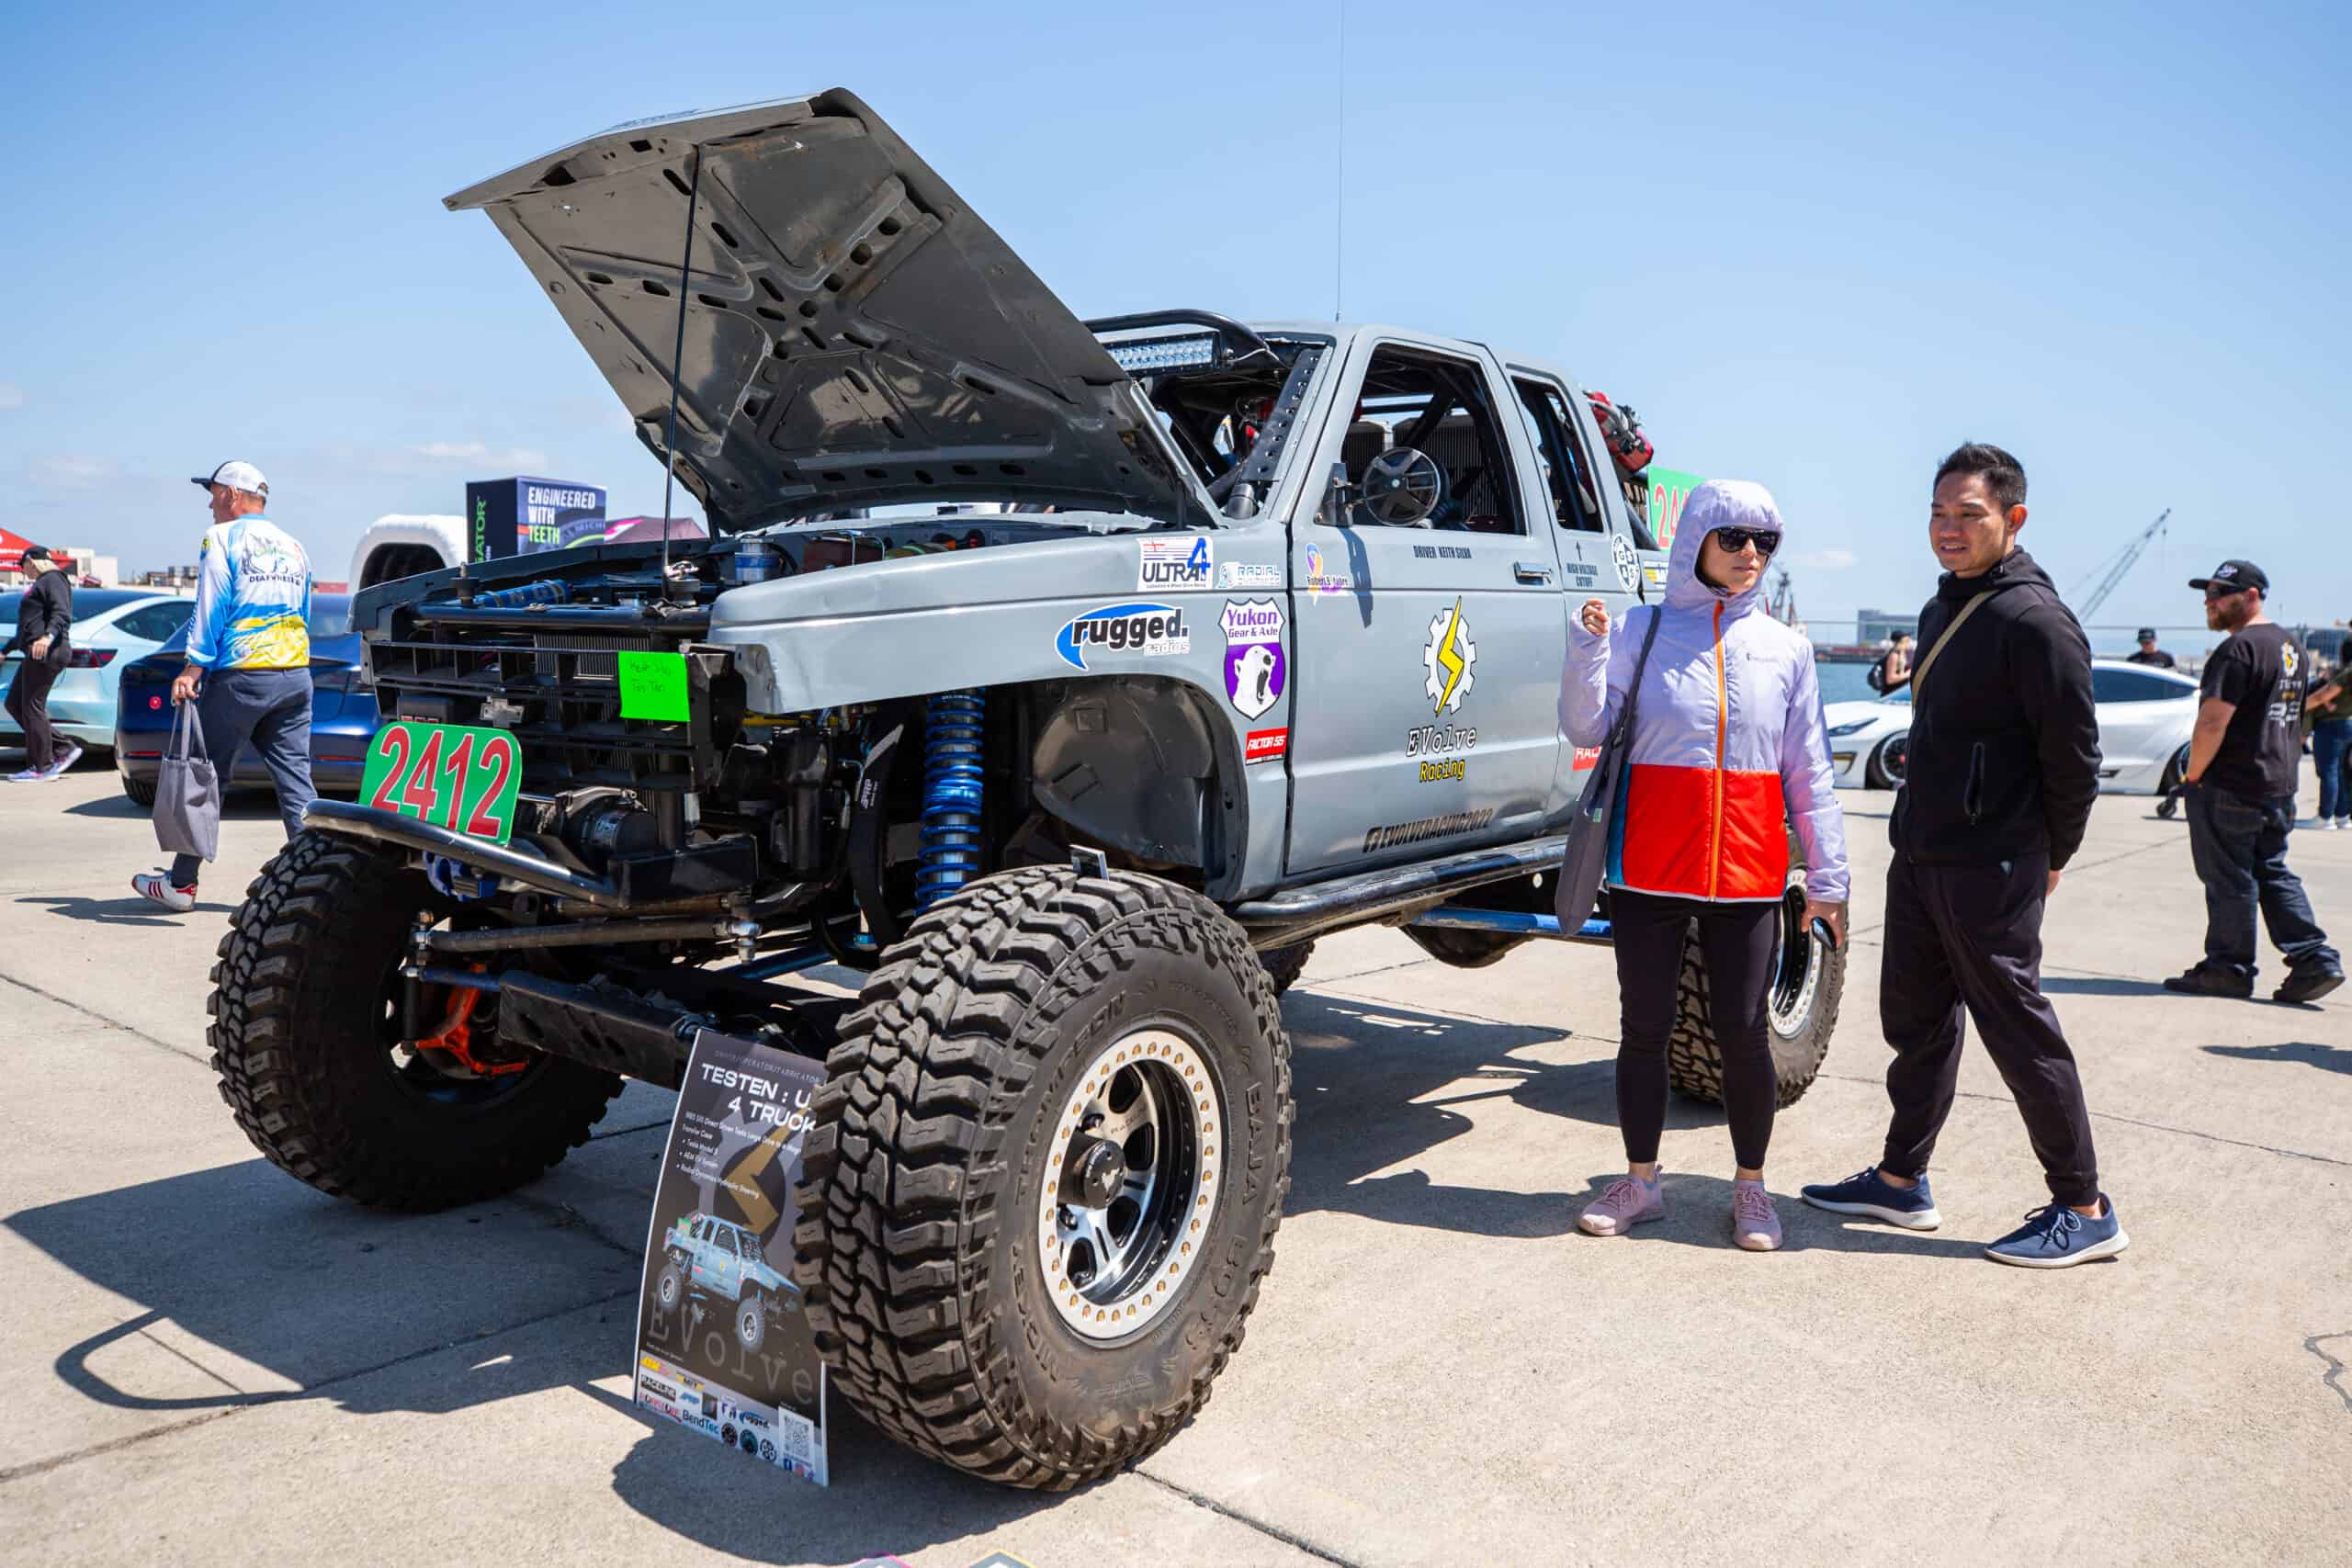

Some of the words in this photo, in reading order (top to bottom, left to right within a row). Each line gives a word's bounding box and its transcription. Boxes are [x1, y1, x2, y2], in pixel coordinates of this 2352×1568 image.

[528, 487, 596, 510] ENGINEERED
[527, 506, 556, 525] WITH
[528, 525, 560, 544] TEETH
[1413, 545, 1436, 558] DRIVER
[1438, 546, 1455, 558] KEITH
[1456, 547, 1472, 558] SILVA
[1238, 566, 1280, 576] RADIAL
[1566, 562, 1579, 573] HIGH
[1580, 564, 1598, 576] VOLTAGE
[1576, 576, 1592, 588] CUTOFF
[1227, 608, 1278, 626] Yukon
[1228, 628, 1250, 638] Gear
[1251, 628, 1258, 637] &
[1260, 626, 1278, 637] Axle
[1145, 642, 1191, 655] radios
[1247, 736, 1274, 750] FACTOR
[1273, 734, 1286, 747] 55
[1406, 724, 1476, 757] EVolve
[1419, 757, 1465, 783] Racing
[370, 726, 513, 839] 2412
[702, 1063, 779, 1100] TESTEN
[728, 1096, 741, 1112] 4
[750, 1099, 817, 1133] TRUCK
[1241, 1081, 1264, 1205] BAJA
